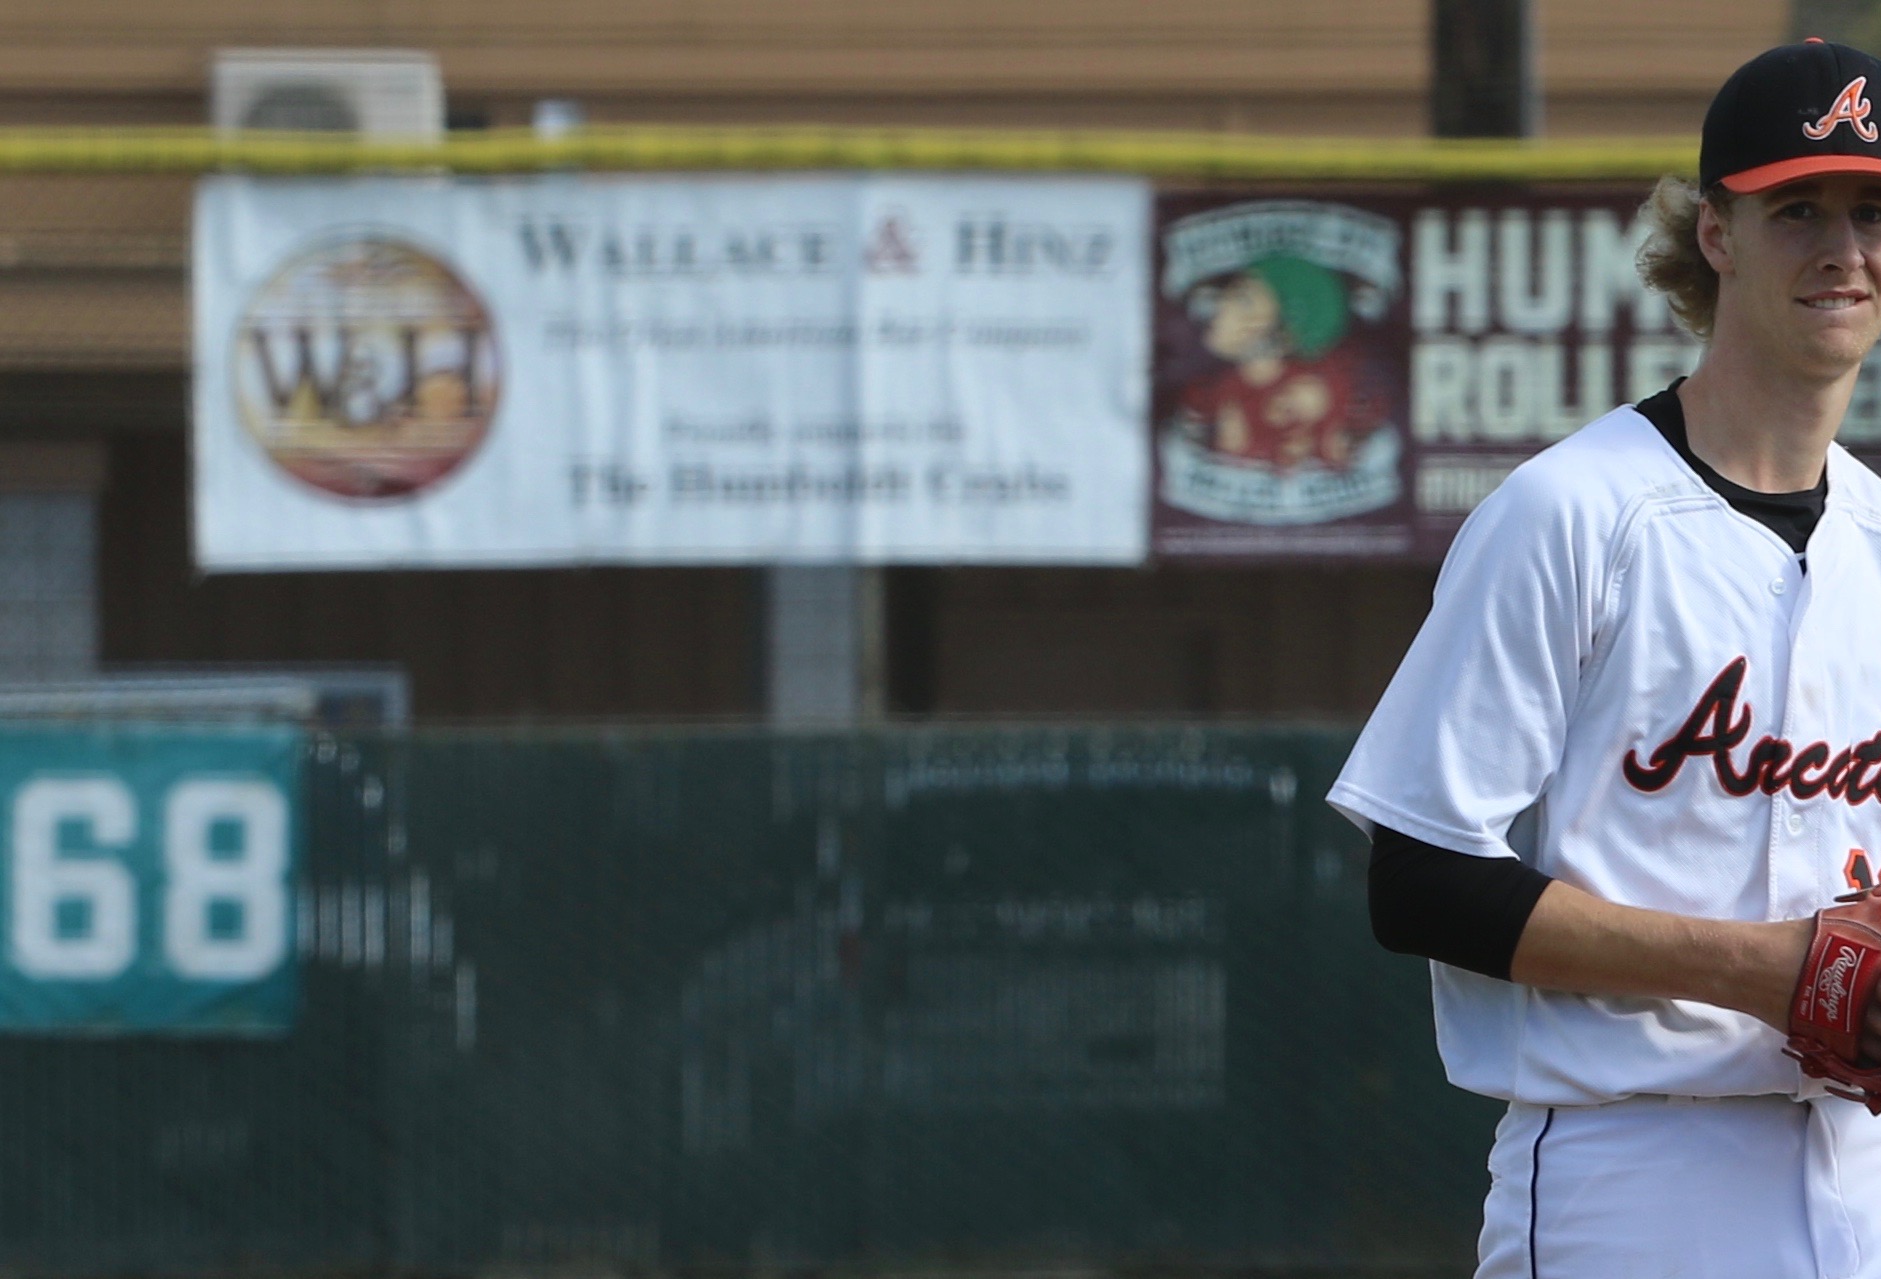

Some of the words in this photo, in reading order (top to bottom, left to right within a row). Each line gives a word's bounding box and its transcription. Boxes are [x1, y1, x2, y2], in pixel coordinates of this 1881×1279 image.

[1802, 75, 1878, 142] A
[860, 215, 922, 280] &
[9, 775, 291, 981] 68
[1819, 945, 1858, 1023] Rawlings
